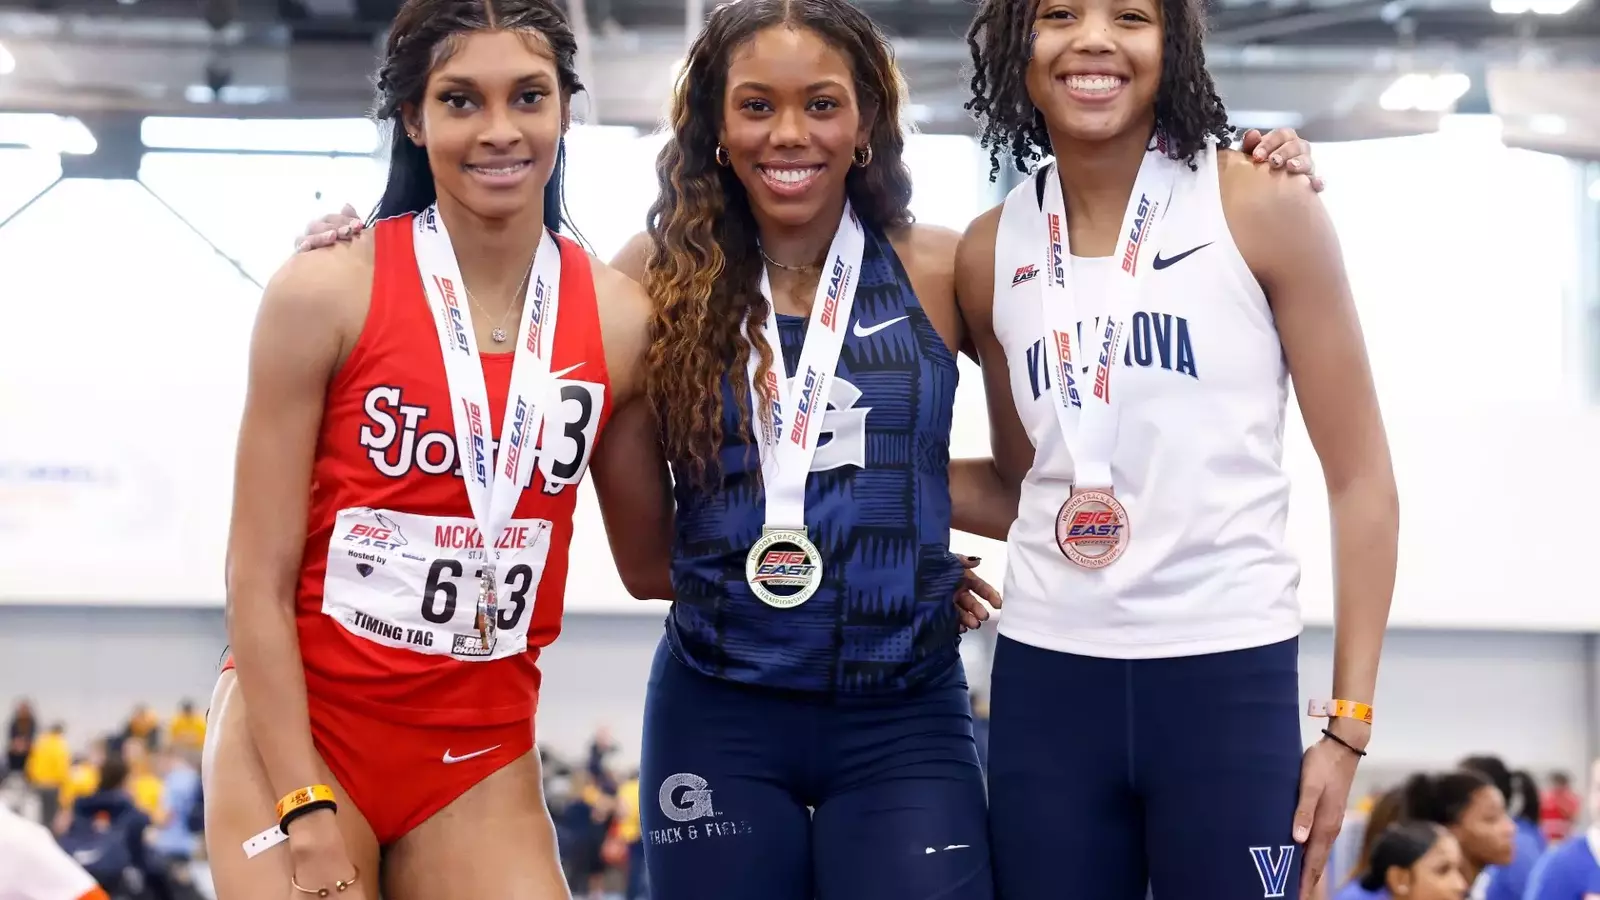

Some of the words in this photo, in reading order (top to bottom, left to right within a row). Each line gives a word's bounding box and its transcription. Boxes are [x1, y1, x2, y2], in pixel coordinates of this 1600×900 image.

[1012, 269, 1040, 284] EAST
[1015, 264, 1035, 276] BIG
[551, 385, 592, 479] 3
[1073, 511, 1114, 525] BIG
[349, 523, 393, 541] BIG
[434, 525, 529, 549] MCKZIE
[1068, 524, 1124, 536] EAST
[347, 549, 375, 562] Hosted
[376, 556, 387, 565] by
[750, 537, 773, 561] INDOOR
[803, 543, 818, 561] FIELD
[763, 550, 808, 565] BIG
[756, 564, 817, 576] EAST
[421, 558, 533, 630] 63
[353, 610, 403, 641] TIMING
[406, 628, 434, 647] TAG
[658, 772, 715, 822] G
[648, 827, 683, 845] TRACK
[687, 825, 698, 840] &
[1248, 845, 1295, 898] V
